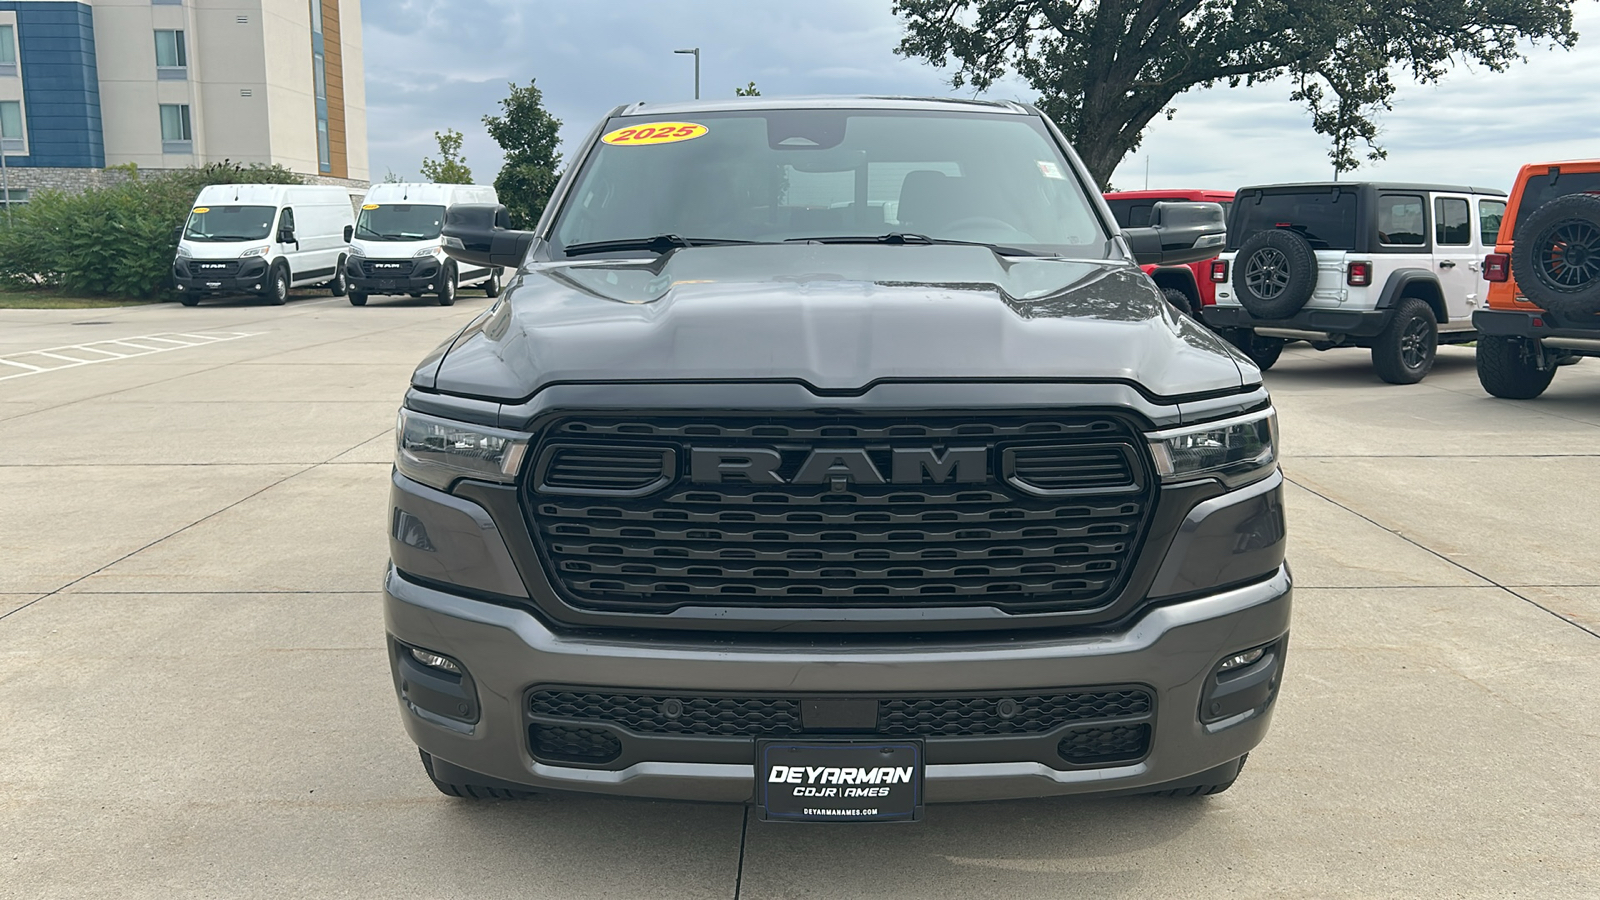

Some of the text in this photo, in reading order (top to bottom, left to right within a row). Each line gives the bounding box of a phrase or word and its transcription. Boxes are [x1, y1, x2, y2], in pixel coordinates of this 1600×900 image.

[611, 126, 698, 142] 2025
[691, 446, 988, 484] RAM
[768, 766, 913, 784] DEYARMAN
